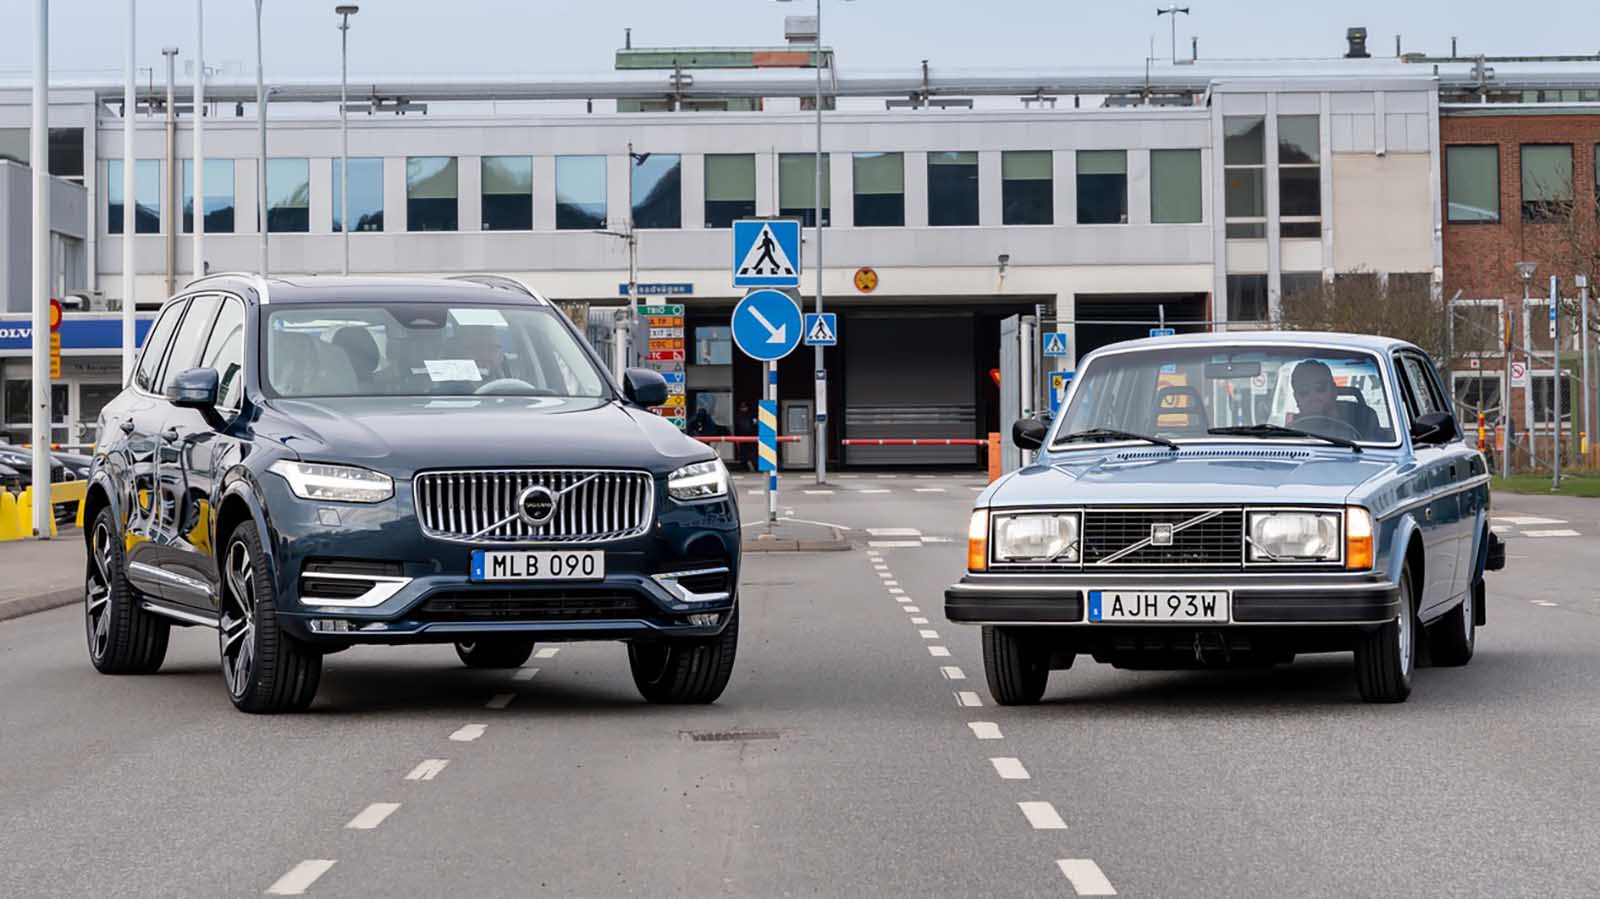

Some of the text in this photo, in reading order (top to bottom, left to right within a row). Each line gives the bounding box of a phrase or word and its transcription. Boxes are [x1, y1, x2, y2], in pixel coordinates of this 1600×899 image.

[0, 328, 33, 338] OLV
[493, 555, 539, 577] MLB
[550, 554, 595, 576] 090
[1111, 594, 1158, 617] AJH
[1167, 594, 1217, 617] 93W
